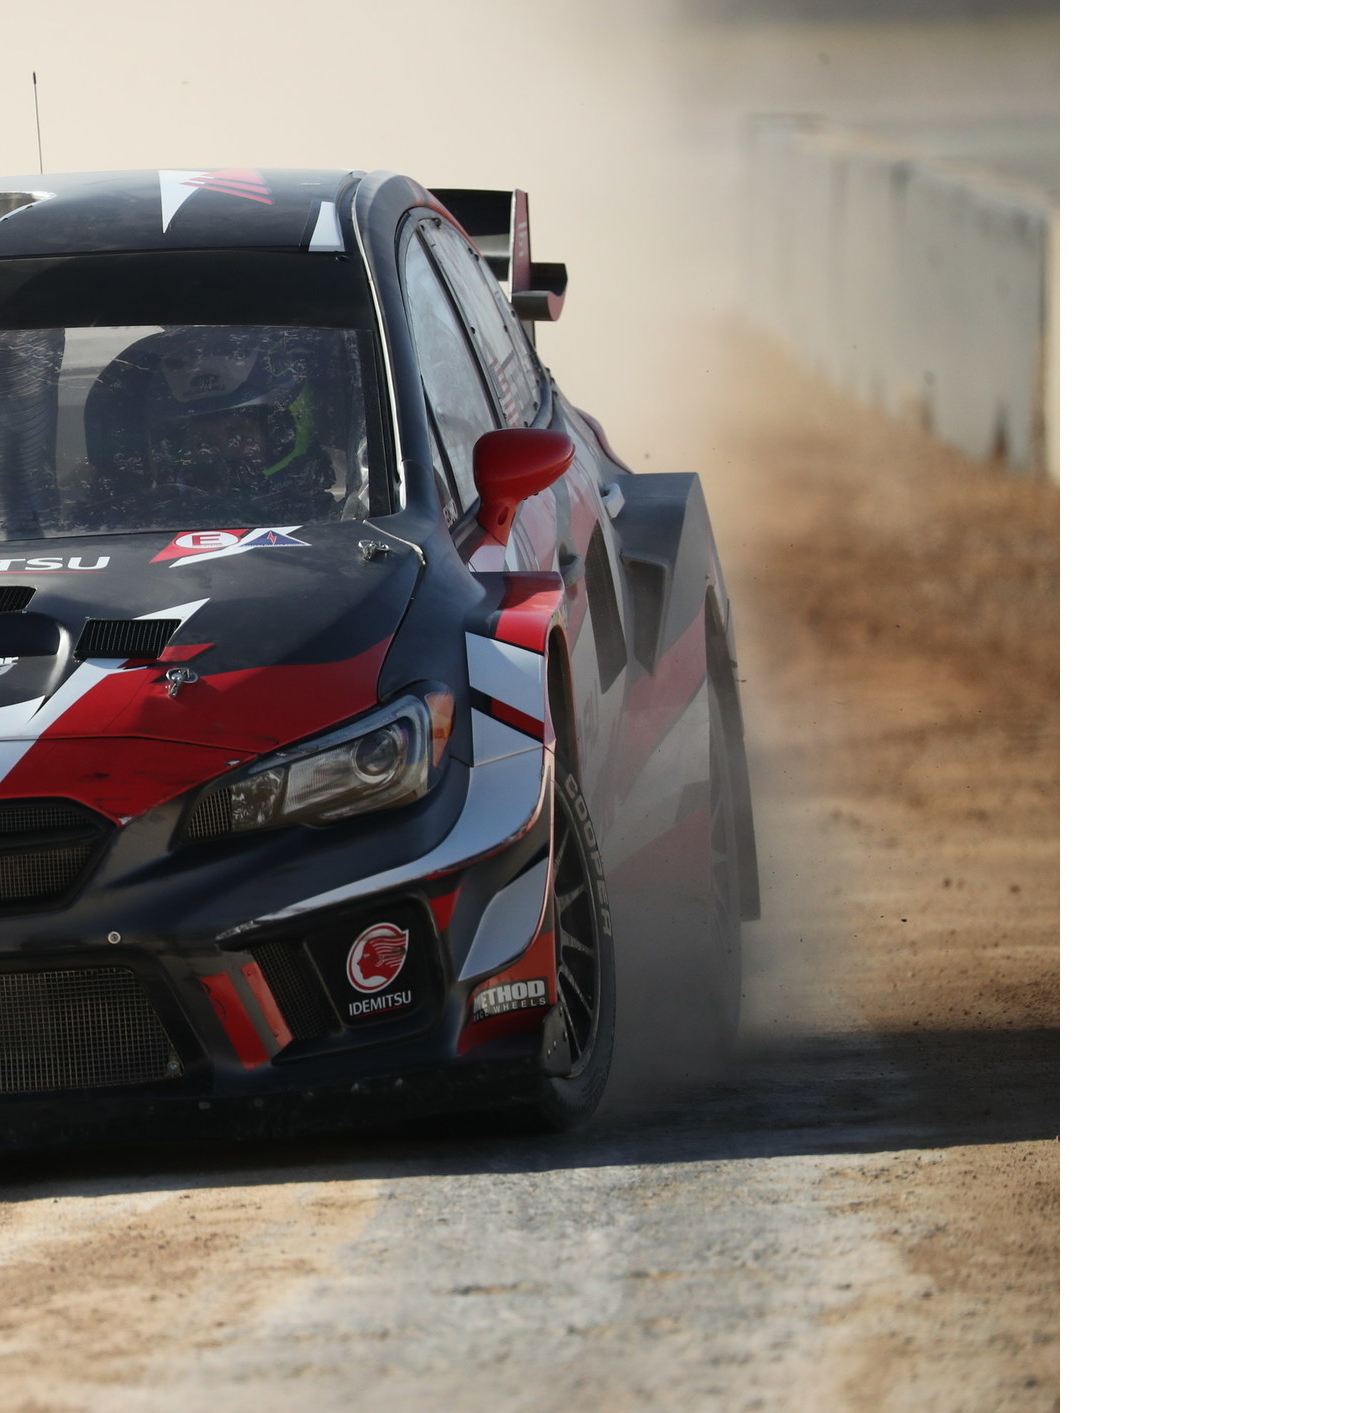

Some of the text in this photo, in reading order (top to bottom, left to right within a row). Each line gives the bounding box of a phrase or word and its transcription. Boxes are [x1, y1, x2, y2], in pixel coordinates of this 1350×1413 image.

[191, 533, 222, 546] E
[564, 773, 612, 937] COOPER
[349, 991, 412, 1016] IDEMITSU
[493, 997, 546, 1013] WHEELS
